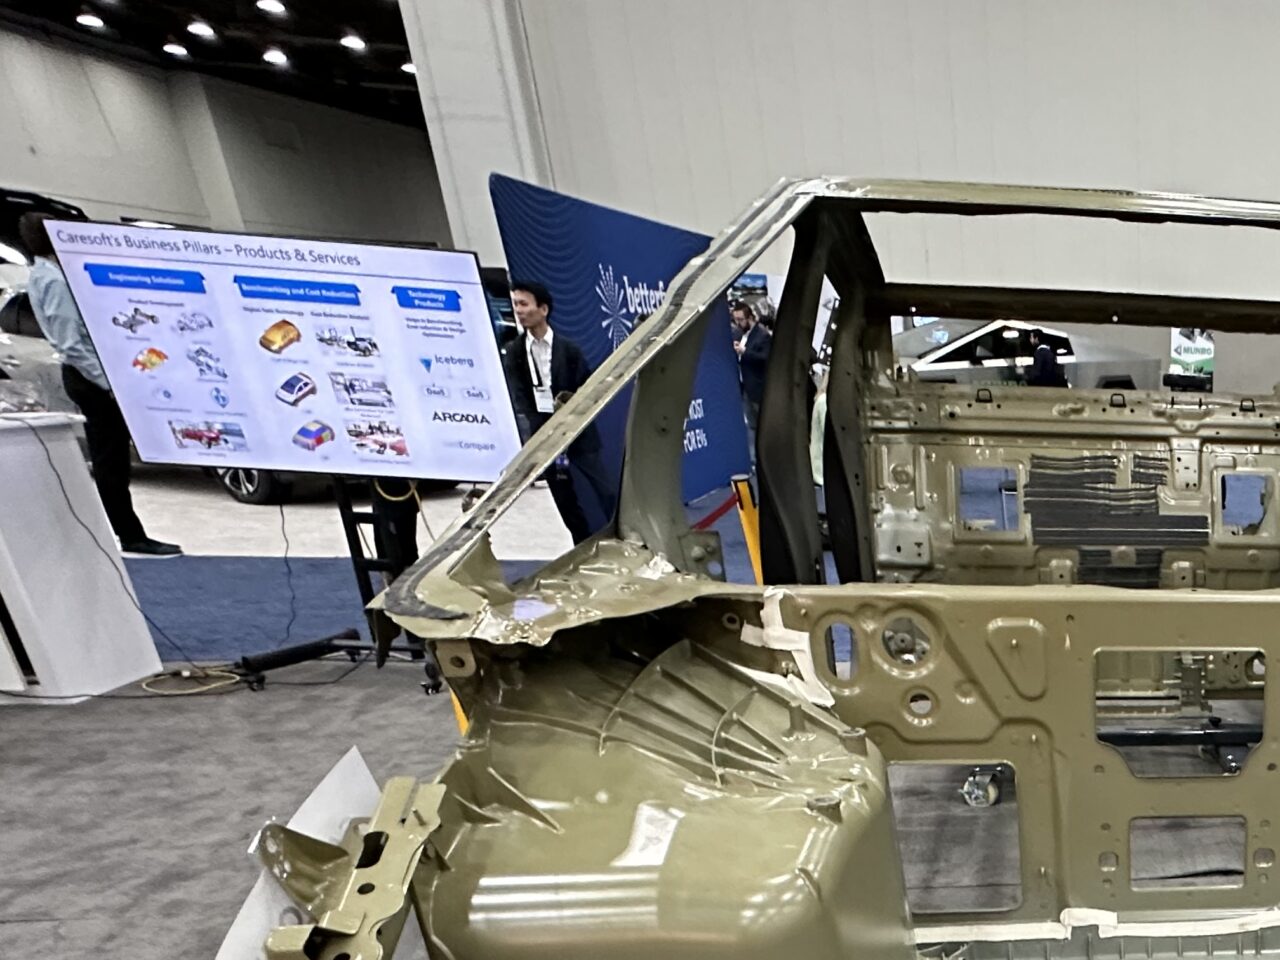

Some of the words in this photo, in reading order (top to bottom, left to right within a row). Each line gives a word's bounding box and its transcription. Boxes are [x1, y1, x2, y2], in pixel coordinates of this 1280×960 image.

[56, 229, 122, 248] Caresoft's
[125, 237, 181, 252] Business
[183, 241, 222, 256] Pillars
[234, 243, 292, 261] Products
[295, 249, 307, 262] &
[309, 251, 361, 267] Services
[623, 275, 667, 314] betterf
[434, 354, 474, 368] Iceberg
[432, 411, 491, 426] ARCADIA
